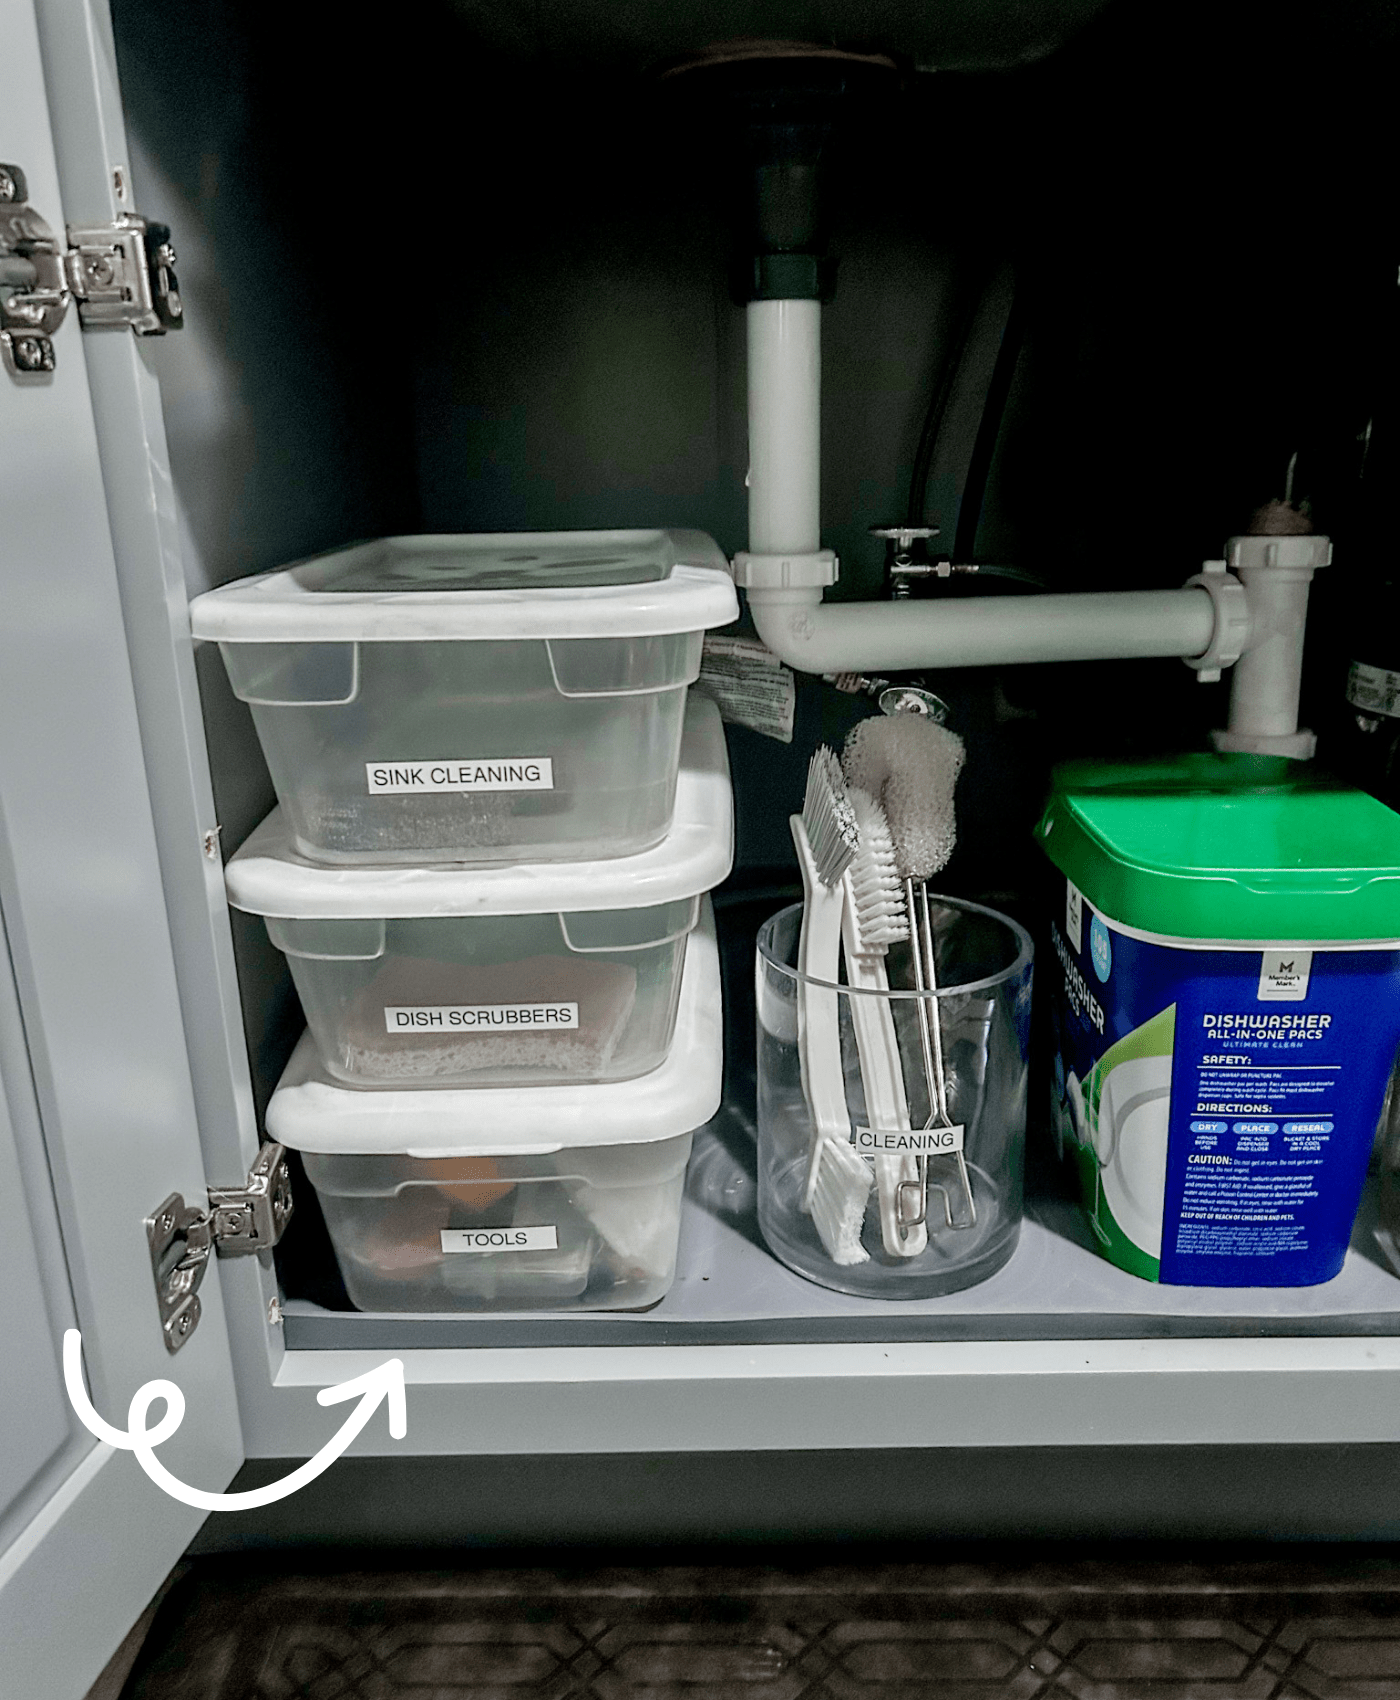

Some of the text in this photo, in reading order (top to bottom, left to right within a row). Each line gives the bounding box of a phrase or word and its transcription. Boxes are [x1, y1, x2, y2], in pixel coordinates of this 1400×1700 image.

[374, 764, 541, 786] SINK CLEANING
[396, 1007, 572, 1026] DISH SCRUBBERS
[1203, 1014, 1331, 1028] DISHWASHER
[1207, 1030, 1323, 1039] ALL-IN-ONE PACS
[1203, 1055, 1251, 1065] SAFETY:
[1197, 1103, 1272, 1113] DIRECTIONS:
[859, 1132, 954, 1149] CLEANING
[1188, 1155, 1232, 1165] CAUTION:
[462, 1232, 527, 1246] TOOLS
